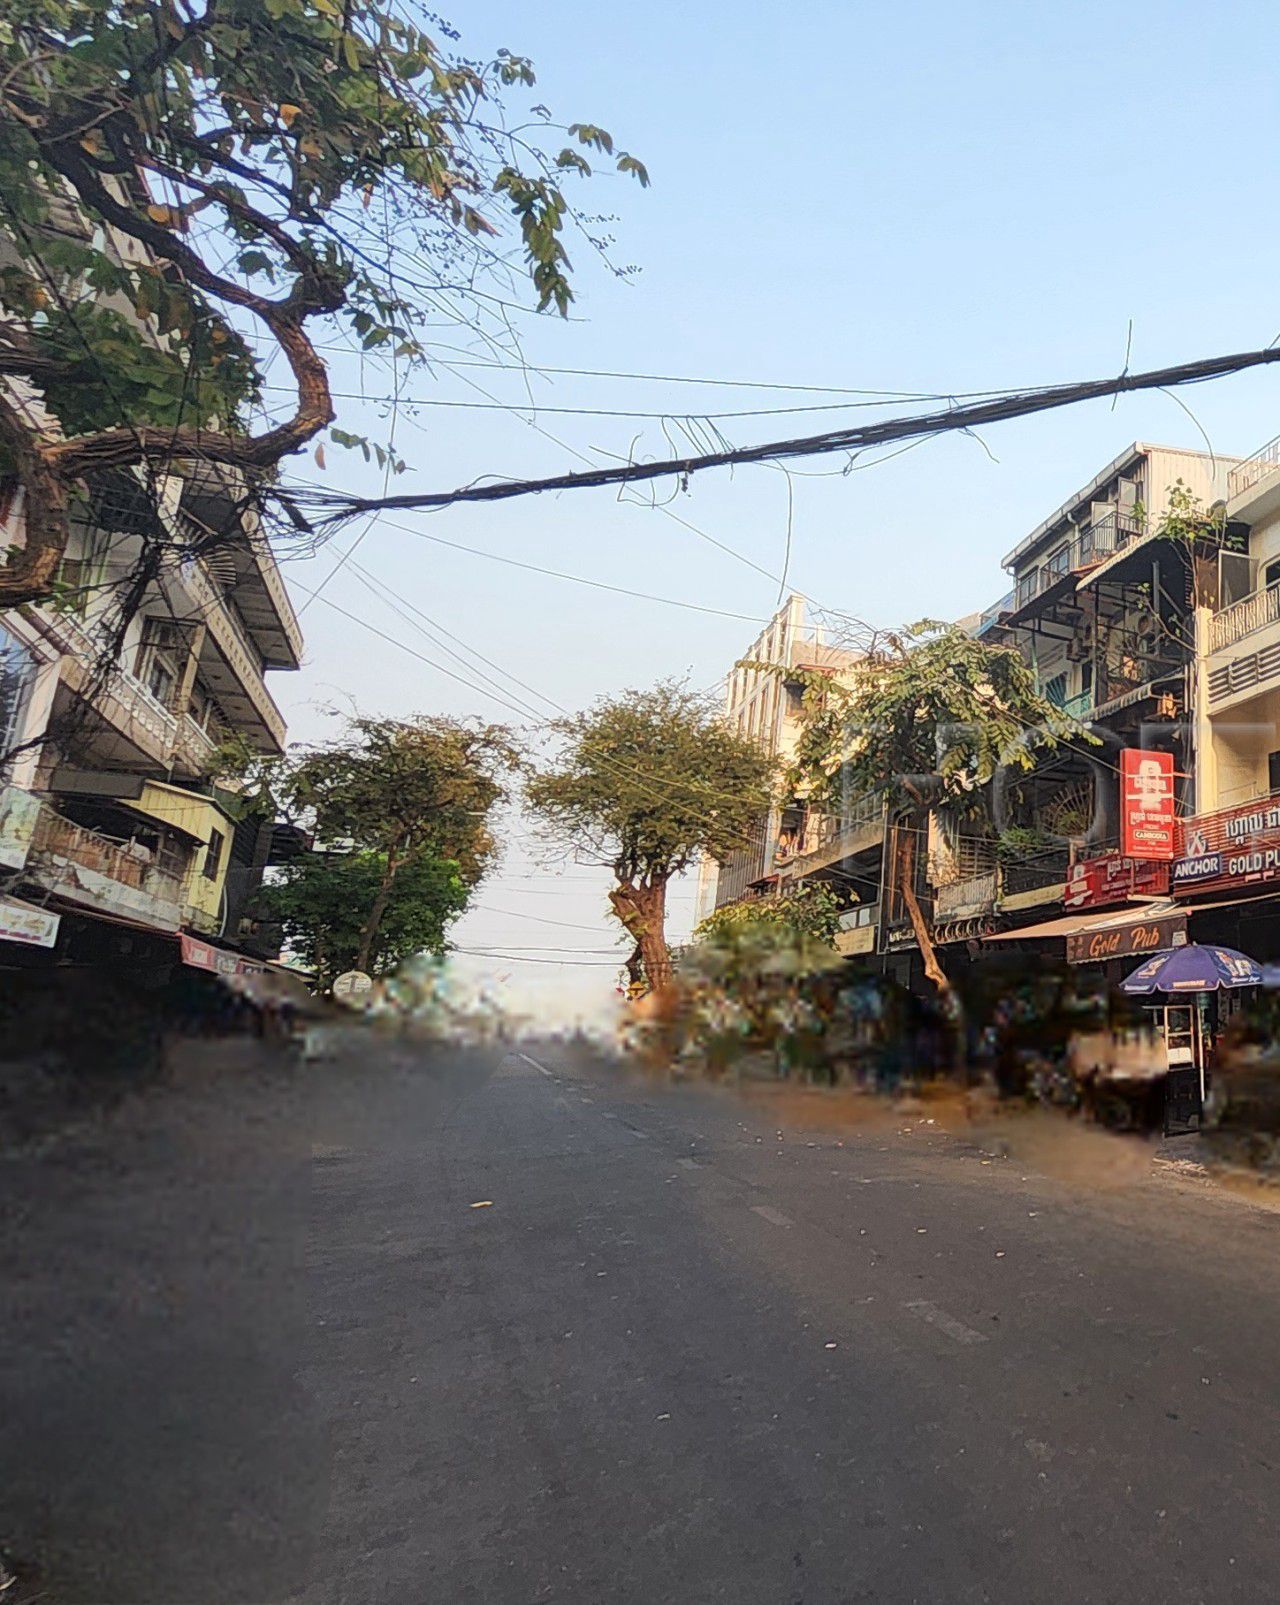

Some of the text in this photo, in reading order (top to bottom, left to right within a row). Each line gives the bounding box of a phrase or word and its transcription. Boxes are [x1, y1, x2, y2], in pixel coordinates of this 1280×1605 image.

[1174, 857, 1219, 879] ANCHOR
[1228, 853, 1262, 876] GOLD
[1090, 932, 1121, 957] Gold
[1130, 926, 1160, 951] Pub
